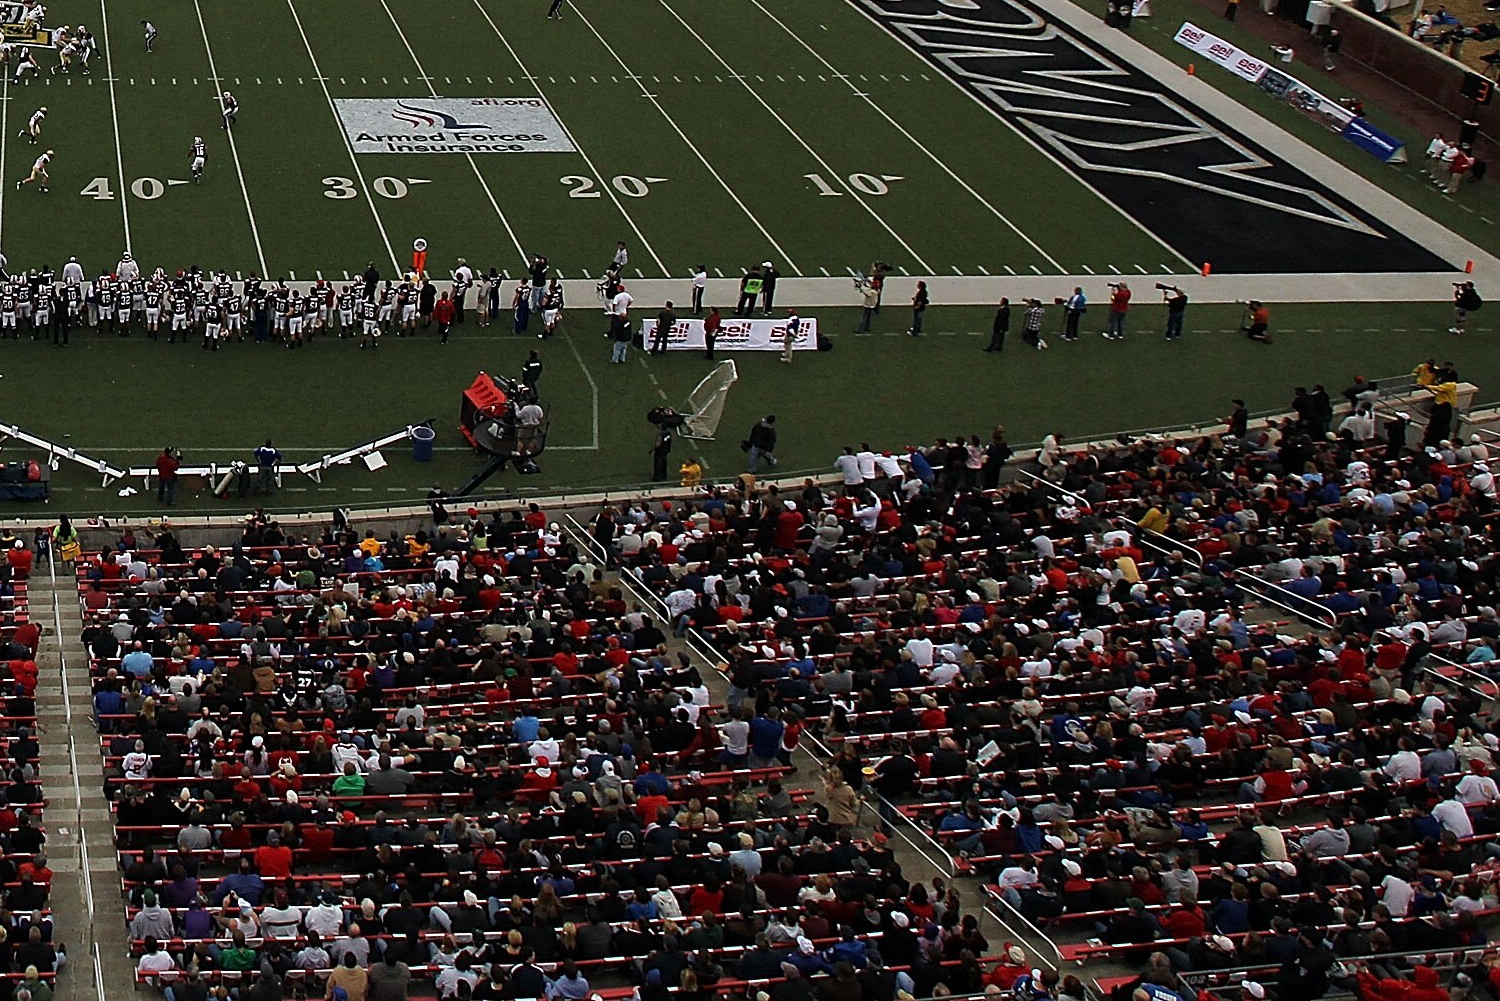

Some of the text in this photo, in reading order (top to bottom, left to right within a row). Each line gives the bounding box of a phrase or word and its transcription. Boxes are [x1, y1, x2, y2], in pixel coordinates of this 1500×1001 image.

[1476, 81, 1489, 102] 3
[471, 99, 542, 107] afi.org
[356, 132, 547, 142] Armed Forces
[196, 147, 204, 156] 16
[388, 143, 524, 152] Insurance
[80, 177, 164, 200] 40
[322, 176, 408, 199] 30
[560, 174, 649, 198] 20
[804, 172, 890, 196] 10
[148, 296, 158, 305] 47
[298, 678, 312, 687] 27
